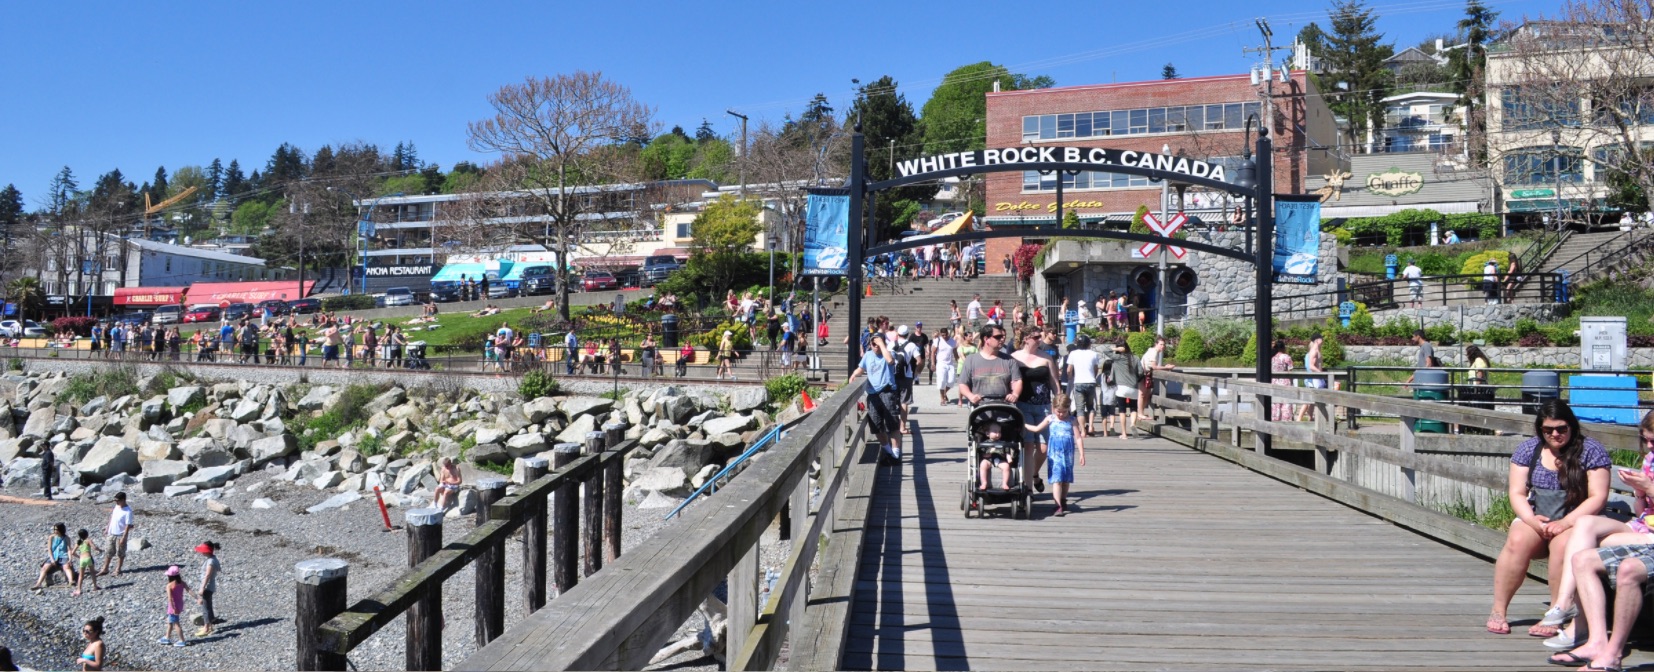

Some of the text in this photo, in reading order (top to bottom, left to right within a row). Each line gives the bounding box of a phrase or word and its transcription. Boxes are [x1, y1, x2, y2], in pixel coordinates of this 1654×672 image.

[896, 147, 1226, 182] WHITE ROCK B.C. CANADA
[995, 200, 1104, 213] Dolce Gelato
[390, 265, 432, 275] RESTAURANT
